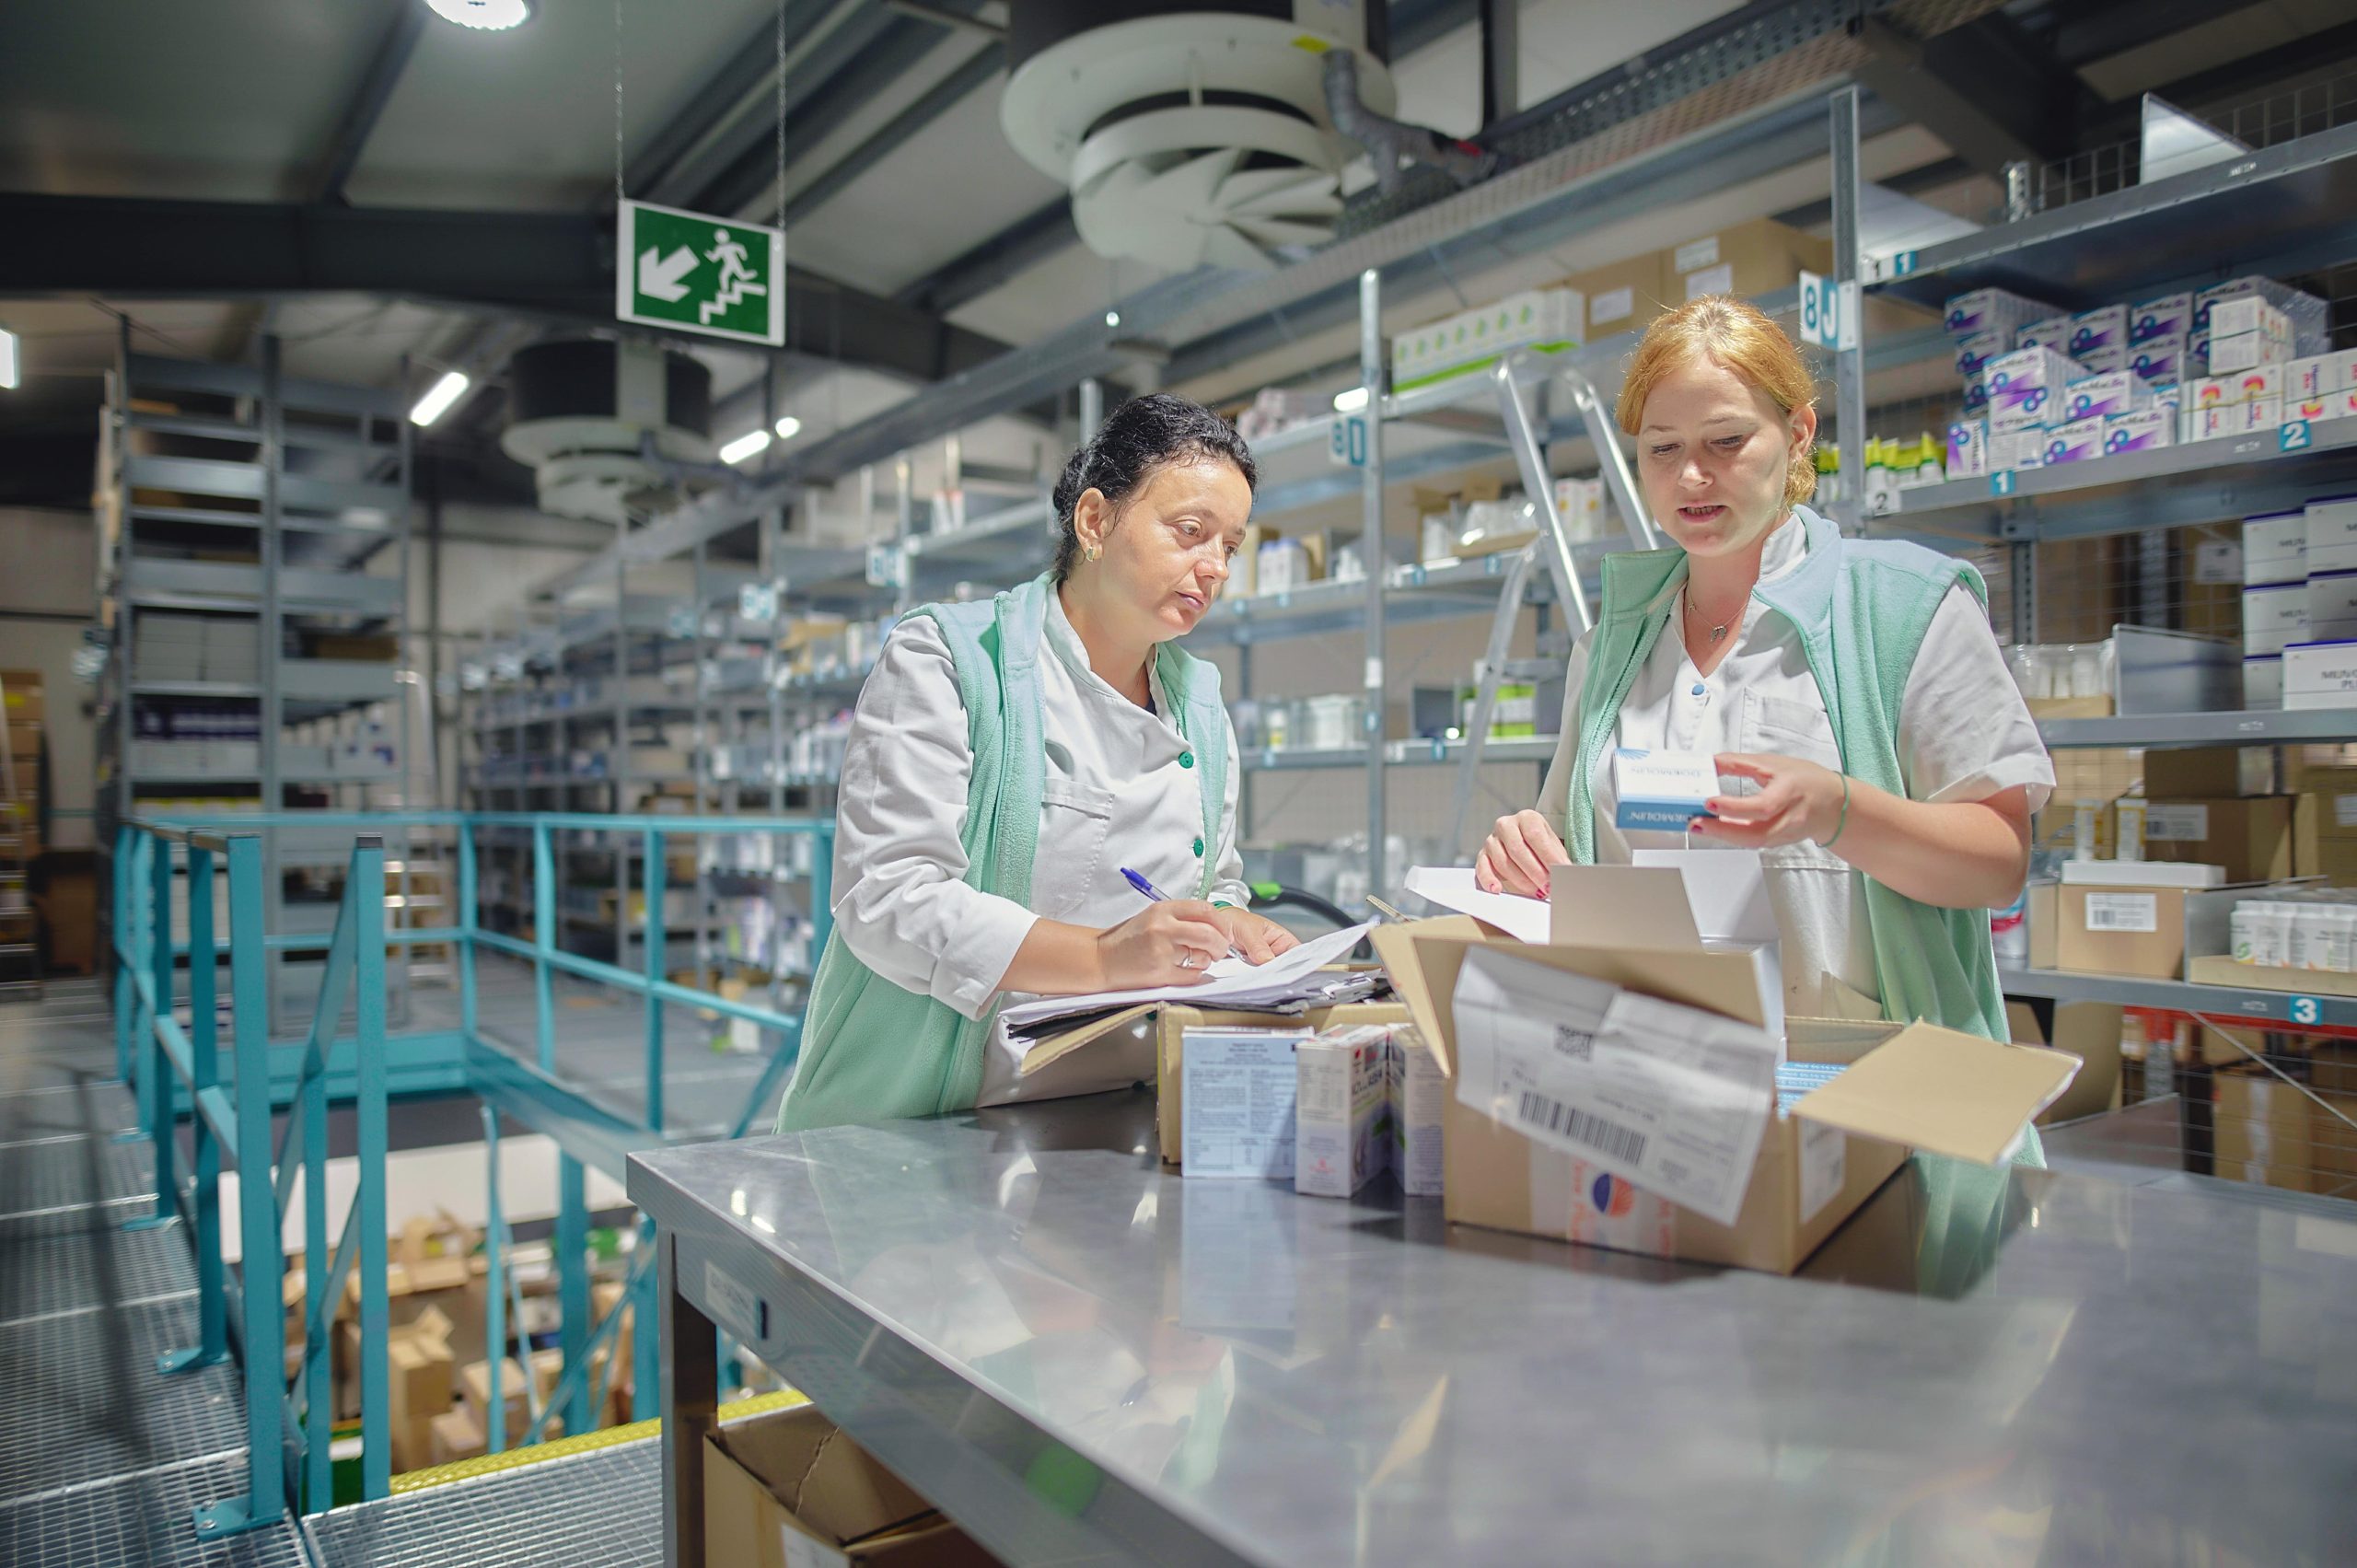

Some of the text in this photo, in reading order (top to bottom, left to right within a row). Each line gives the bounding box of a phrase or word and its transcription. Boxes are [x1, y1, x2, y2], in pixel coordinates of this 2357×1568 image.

[1899, 252, 1910, 273] 1
[1805, 285, 1837, 340] 8J
[2283, 423, 2306, 448] 2
[1995, 471, 2008, 494] 1
[1875, 493, 1887, 510] 2
[2294, 998, 2316, 1024] 3
